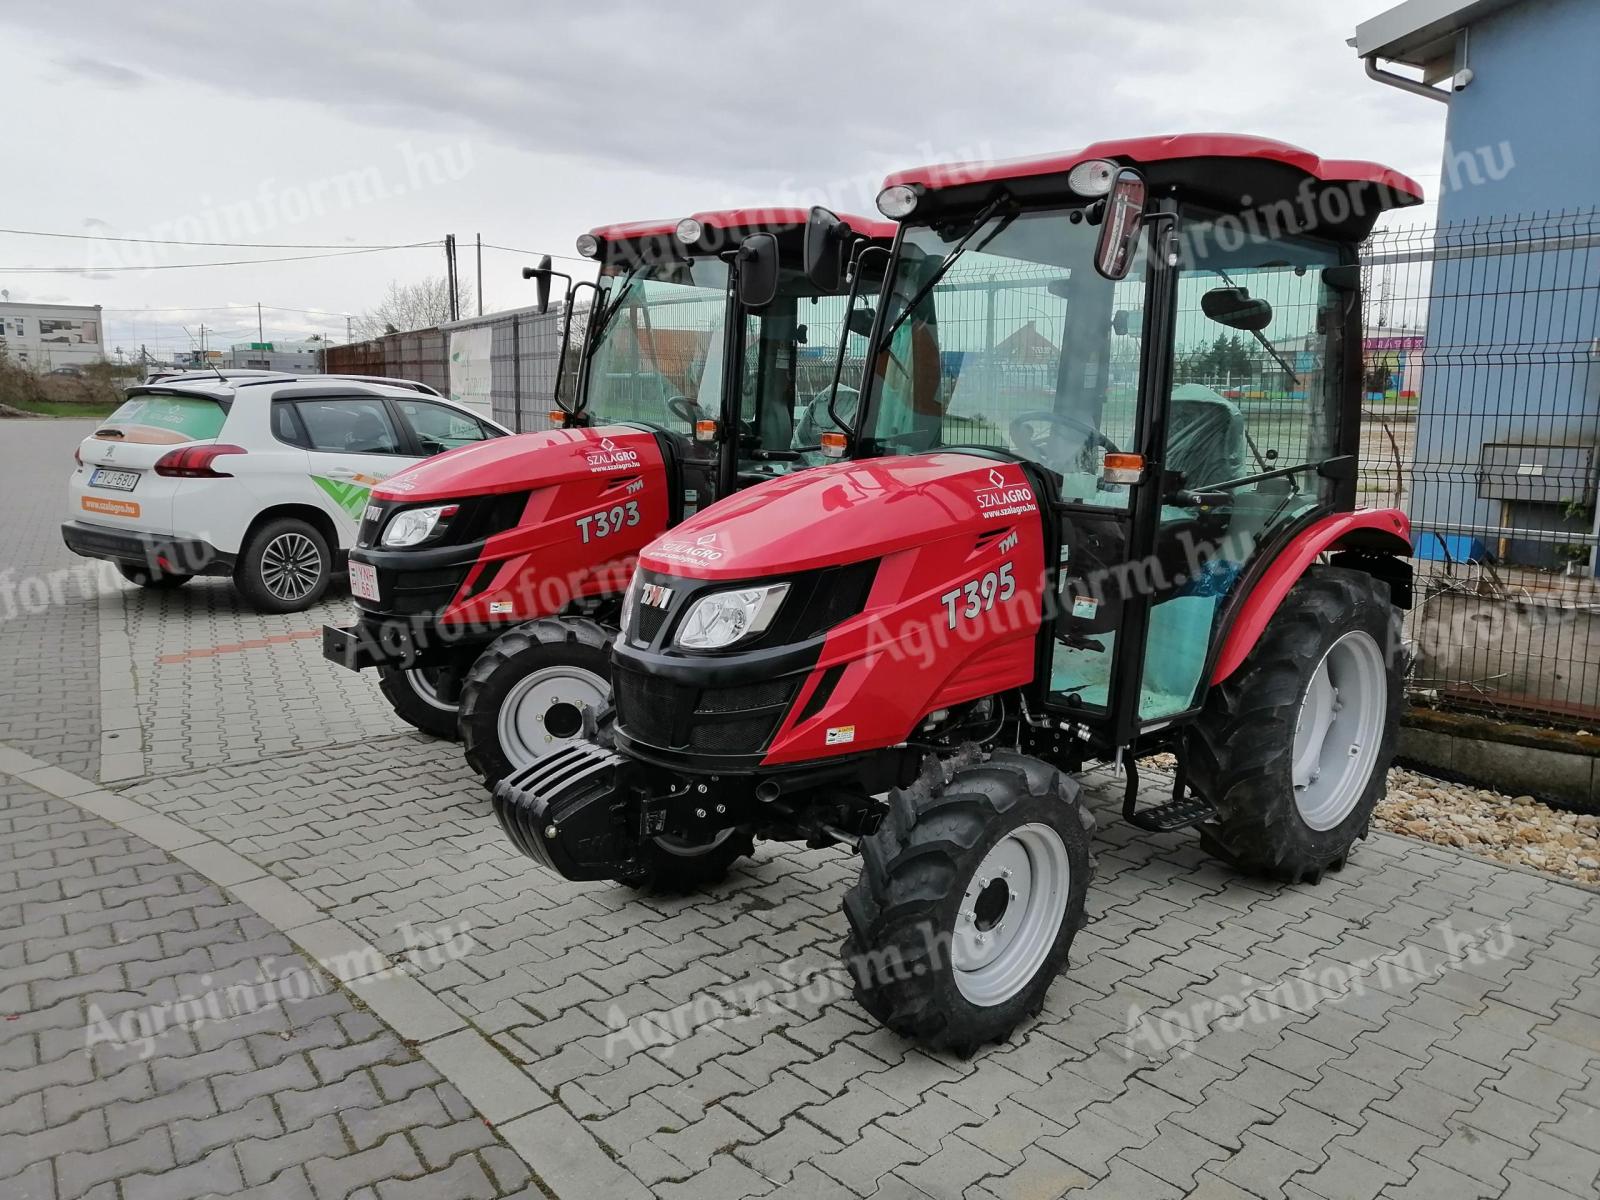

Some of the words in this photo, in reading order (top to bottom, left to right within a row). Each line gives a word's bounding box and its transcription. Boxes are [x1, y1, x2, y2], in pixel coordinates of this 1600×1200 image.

[587, 450, 637, 465] SZALAGRO
[591, 461, 640, 473] www.szalagro.hu
[976, 488, 1032, 509] SZALAGRO
[982, 503, 1037, 519] www.szalagro.hu
[576, 501, 640, 544] T393
[999, 531, 1018, 555] TYM
[941, 561, 1016, 629] T395
